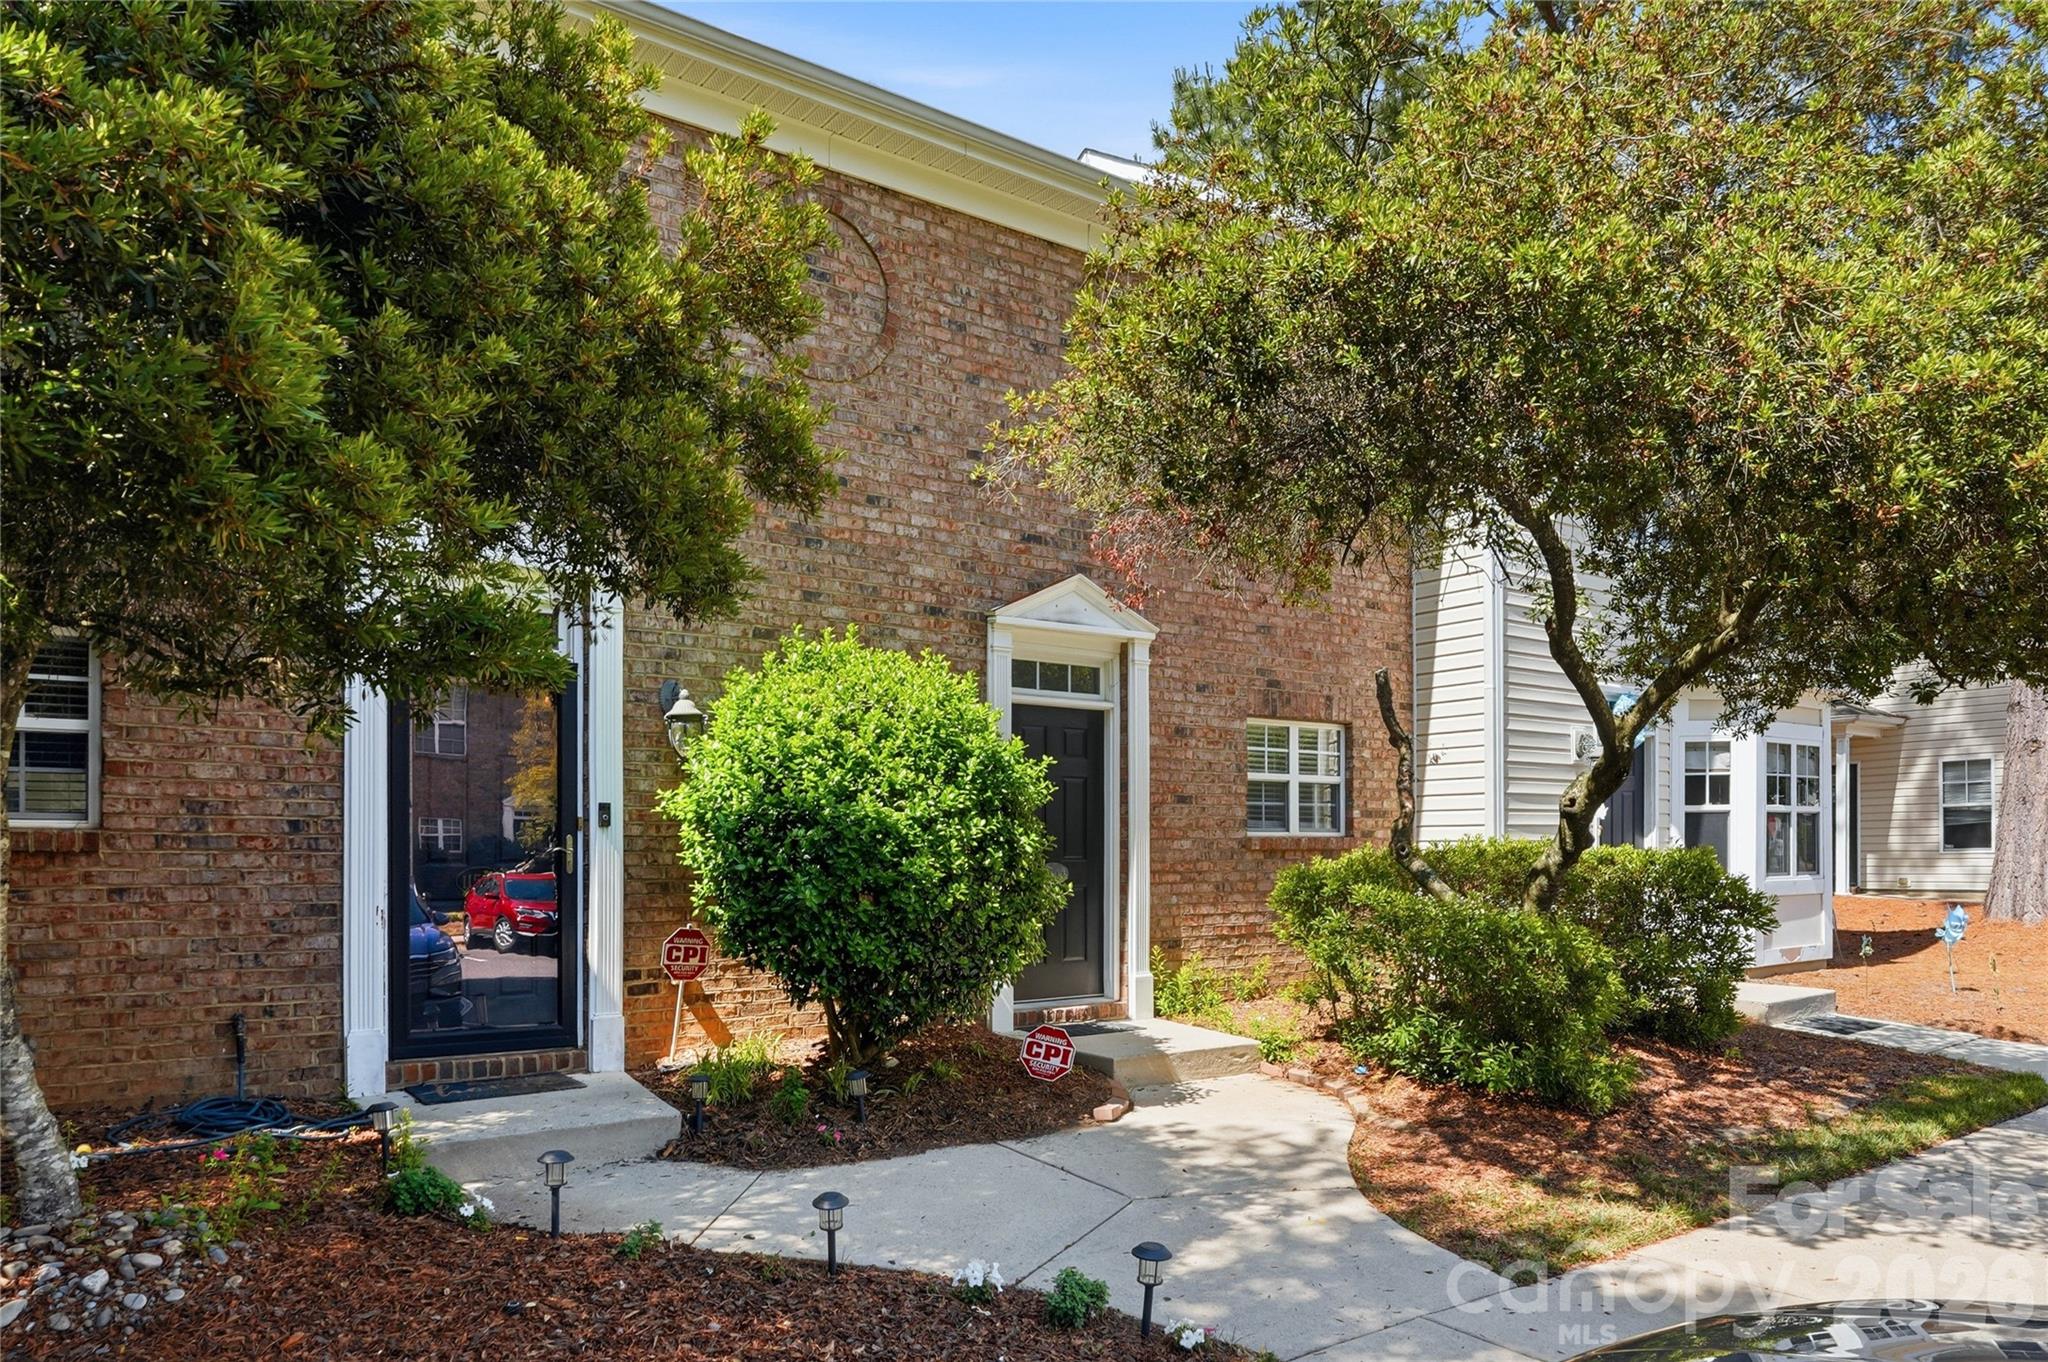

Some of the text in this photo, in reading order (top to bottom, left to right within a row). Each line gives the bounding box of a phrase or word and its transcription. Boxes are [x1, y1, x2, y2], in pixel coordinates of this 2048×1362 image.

[673, 937, 704, 945] WARNING
[666, 946, 708, 963] CPI
[670, 964, 699, 972] SECURITY
[1035, 1032, 1068, 1046] WARNING
[1025, 1040, 1071, 1066] CPI
[1029, 1060, 1060, 1073] SECURITY
